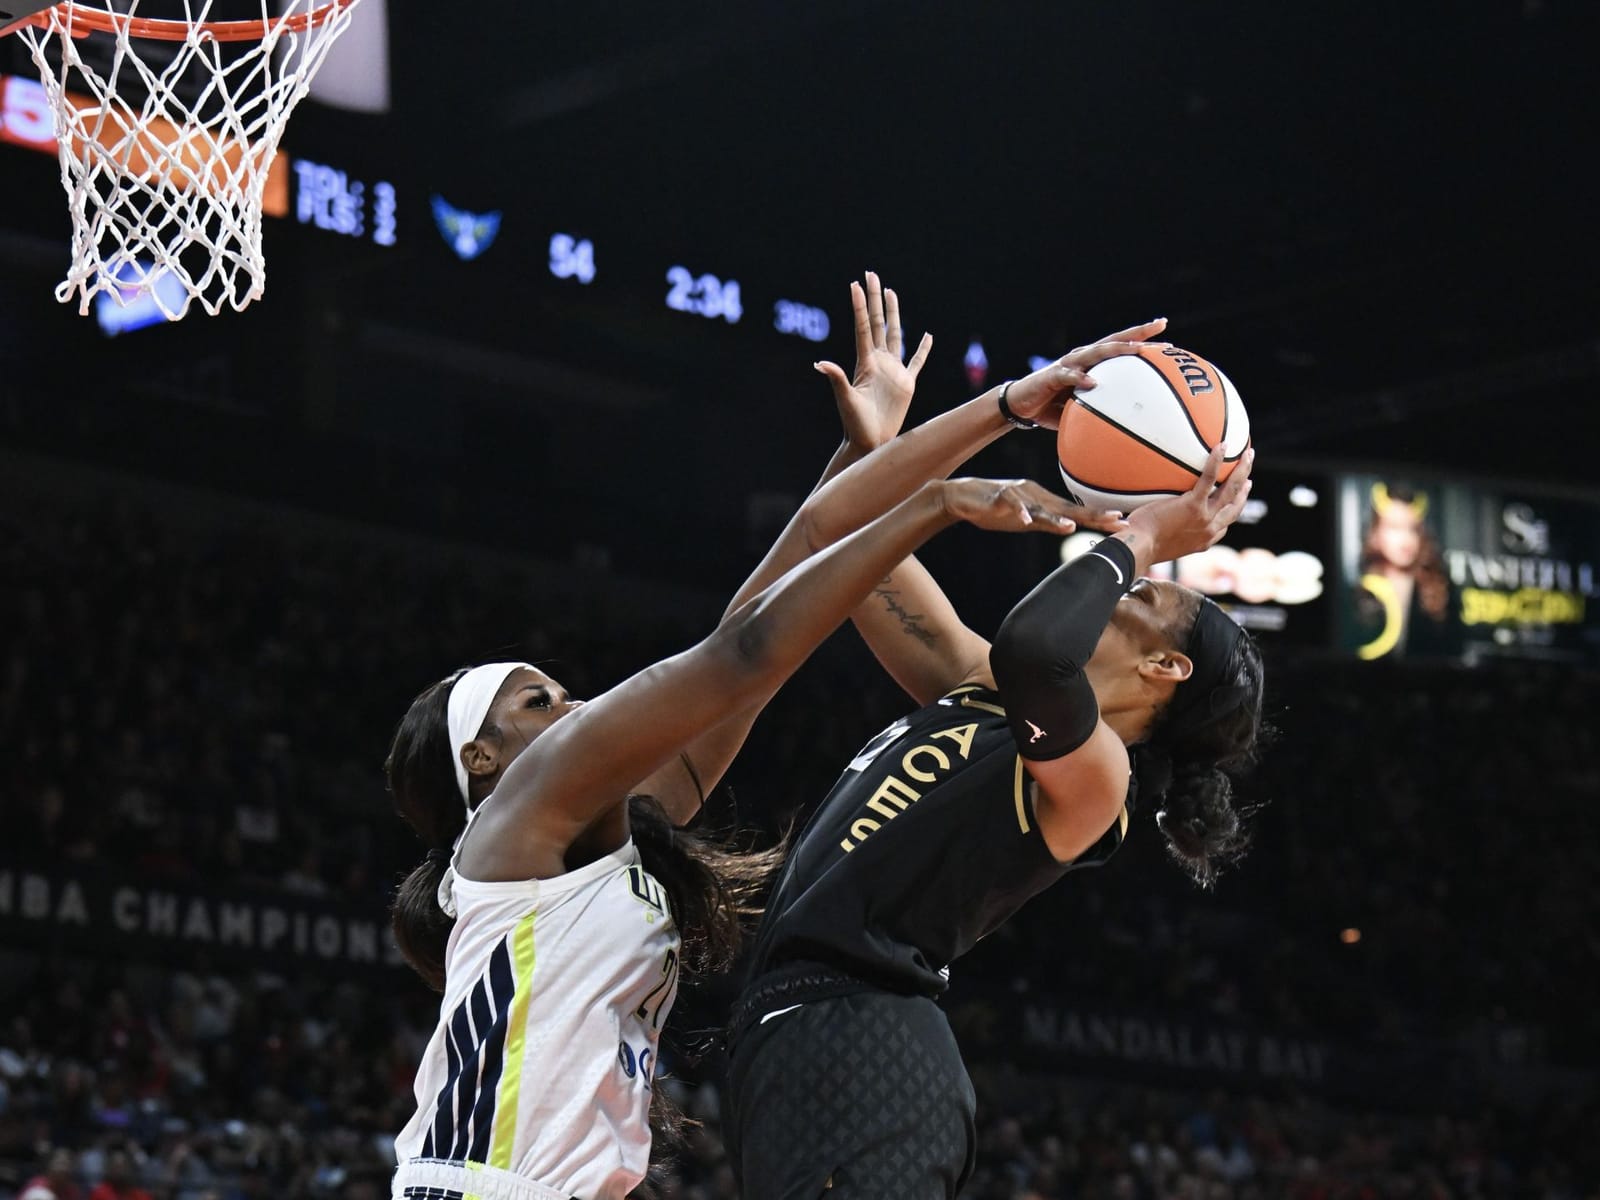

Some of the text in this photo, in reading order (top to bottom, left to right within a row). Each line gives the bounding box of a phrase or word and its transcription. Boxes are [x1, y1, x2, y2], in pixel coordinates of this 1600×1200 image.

[549, 232, 596, 285] 54
[666, 265, 743, 324] 2:34
[1162, 344, 1215, 398] Wil
